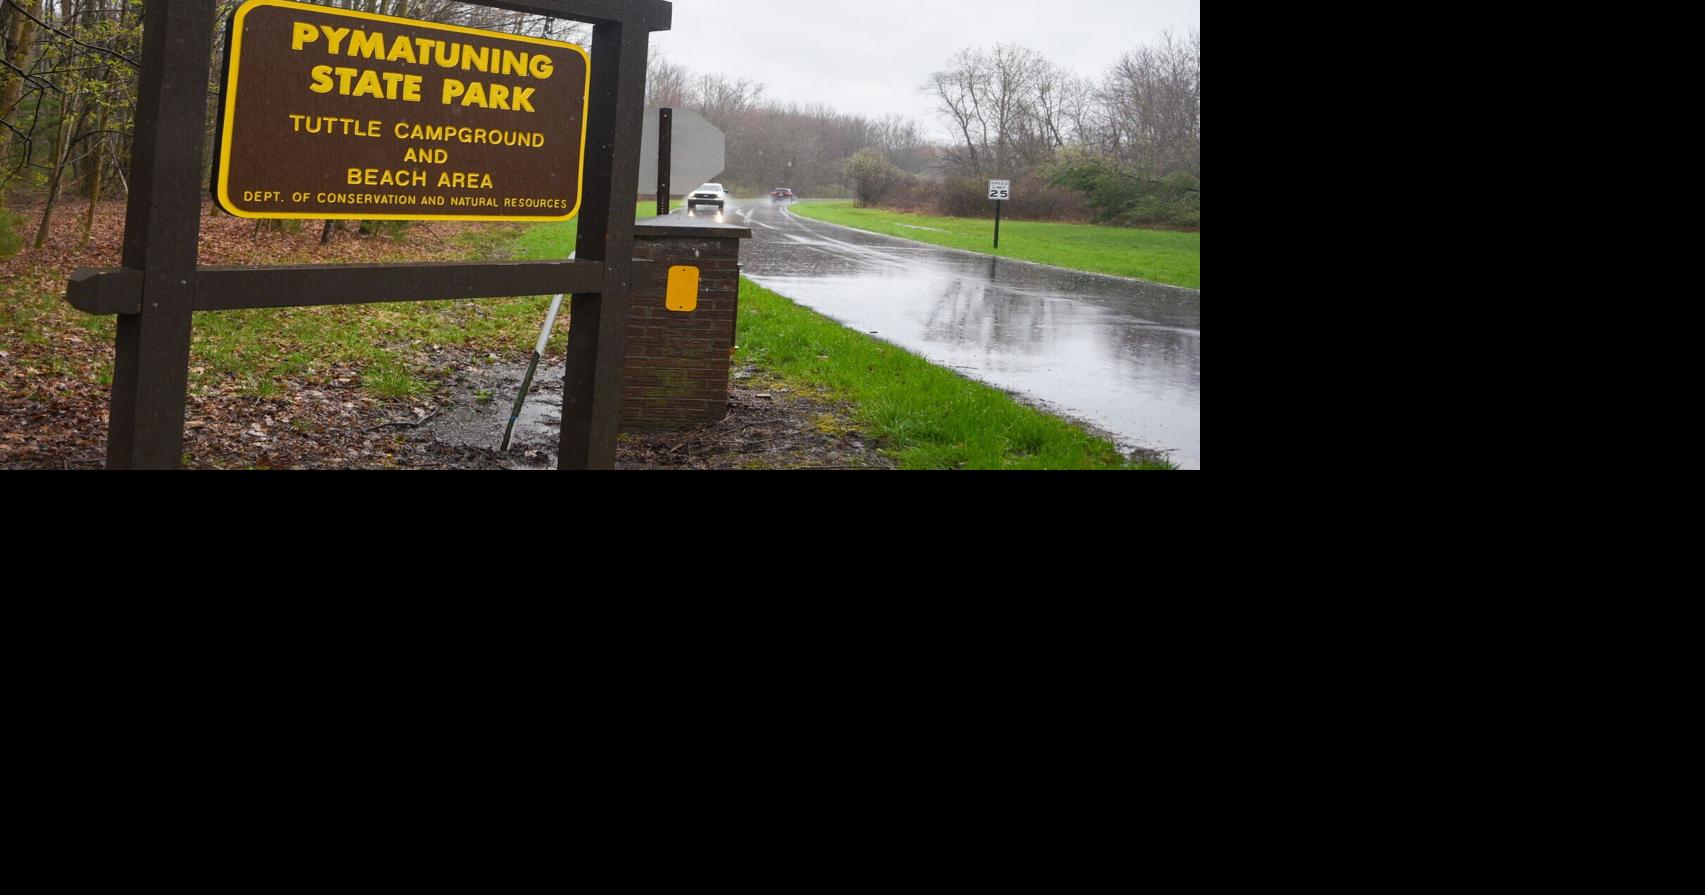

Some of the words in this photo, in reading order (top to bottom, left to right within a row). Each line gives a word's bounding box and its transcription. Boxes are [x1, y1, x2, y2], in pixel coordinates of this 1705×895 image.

[292, 22, 554, 80] PYMATUNING
[309, 65, 423, 102] STATE
[442, 78, 536, 113] PARK
[289, 114, 383, 138] TUTTLE
[394, 122, 545, 148] CAMPGROUND
[403, 148, 448, 164] AND
[347, 168, 427, 187] BEACH
[437, 172, 493, 189] AREA
[243, 190, 285, 203] DEPT.
[291, 192, 311, 203] OF
[317, 192, 416, 205] CONSERVATION
[421, 195, 445, 206] AND
[450, 196, 499, 207] NATURAL
[504, 197, 567, 209] RESOURCES
[990, 190, 1008, 198] 25
